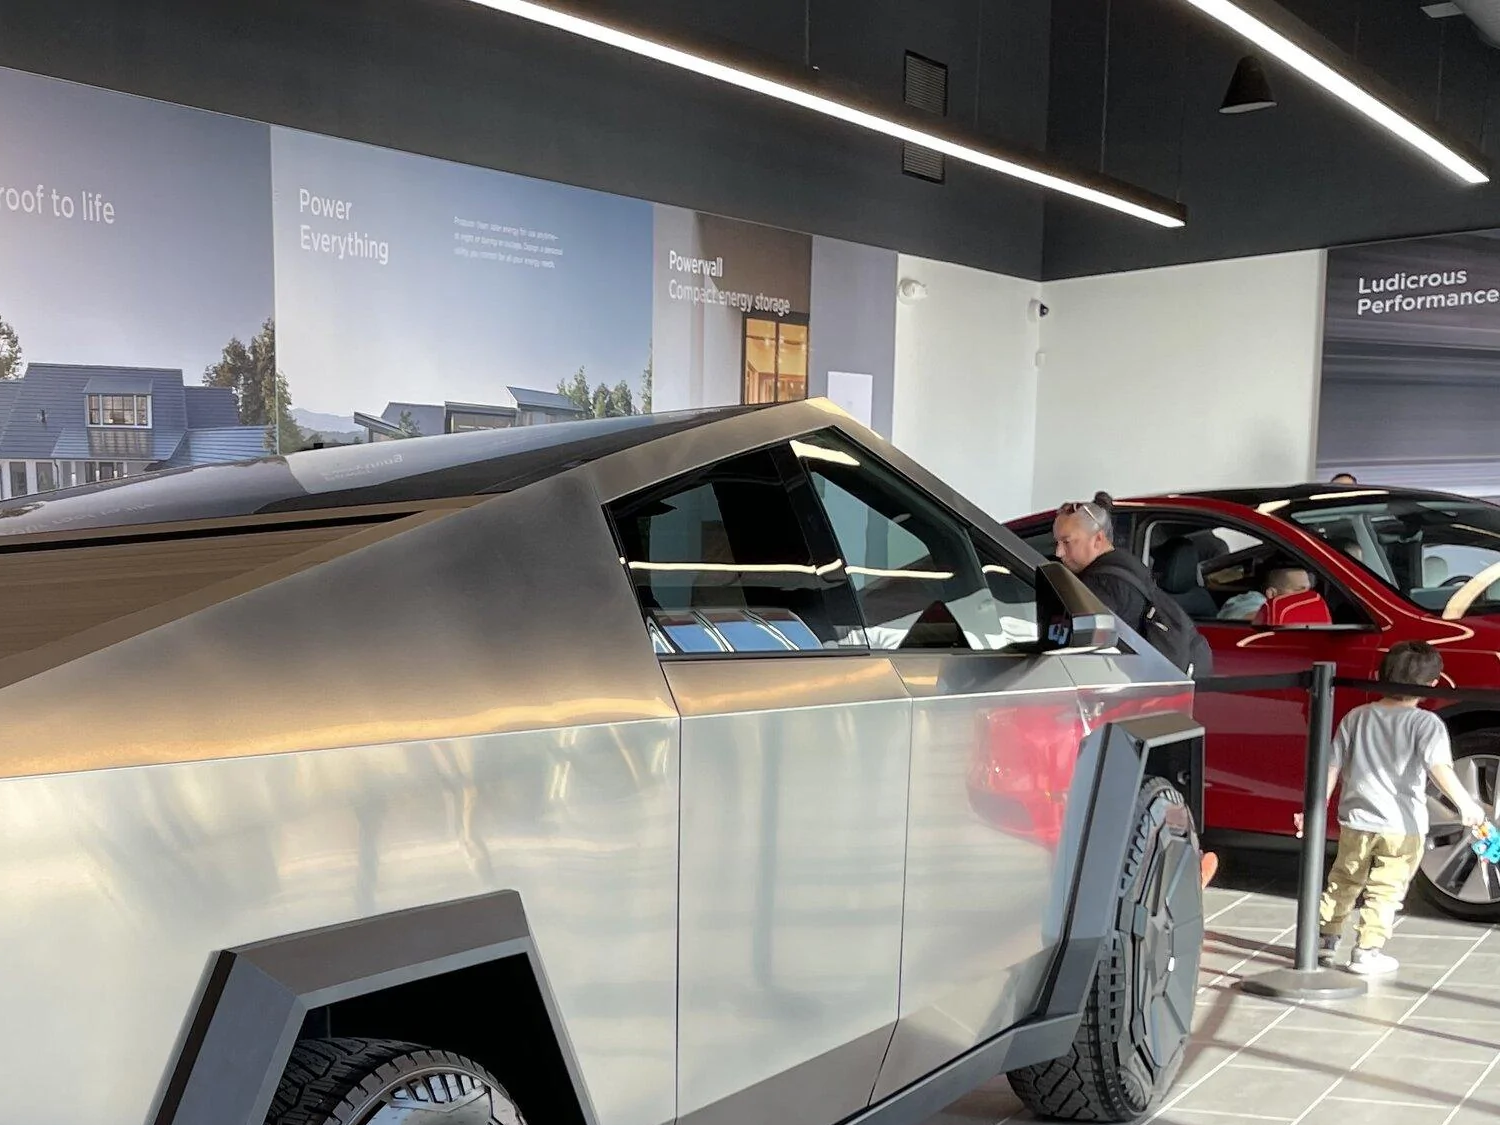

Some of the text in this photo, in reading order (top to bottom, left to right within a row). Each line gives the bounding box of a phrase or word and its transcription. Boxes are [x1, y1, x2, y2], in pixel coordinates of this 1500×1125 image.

[51, 188, 75, 218] to
[82, 191, 115, 224] life
[299, 189, 352, 220] Power
[300, 224, 389, 265] Everything
[668, 250, 723, 277] Powerwall
[668, 279, 791, 316] Compact energy storage
[1358, 270, 1468, 294] Ludicrous
[1357, 288, 1499, 316] Performance
